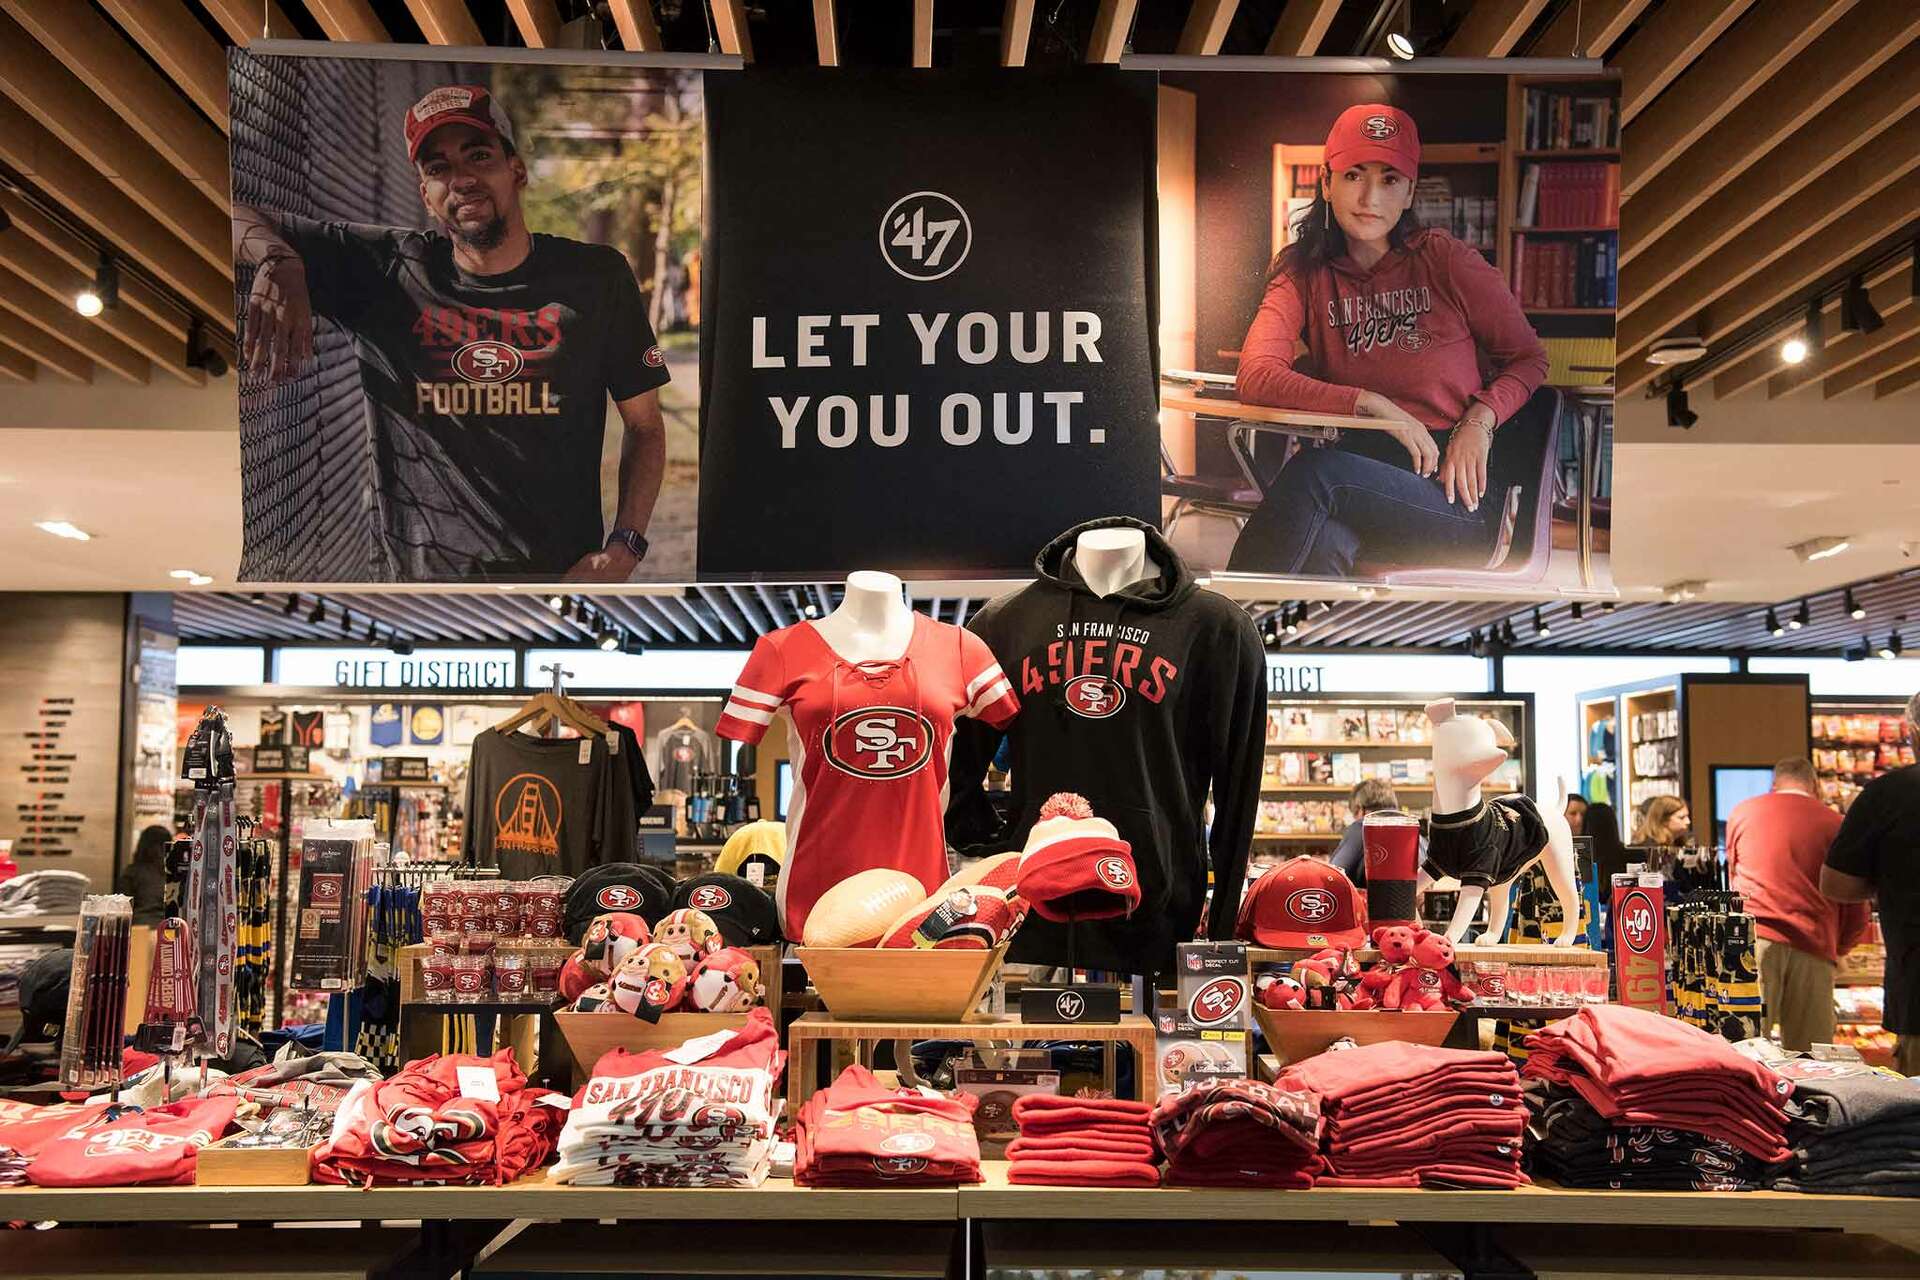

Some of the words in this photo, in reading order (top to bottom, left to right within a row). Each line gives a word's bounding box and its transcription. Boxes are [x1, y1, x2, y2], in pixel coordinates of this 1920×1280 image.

[1328, 298, 1352, 328] SN
[1357, 286, 1432, 322] FRANCISCO
[412, 303, 563, 348] 49ERS
[752, 314, 880, 368] LET
[907, 311, 1104, 366] YOUR
[472, 347, 510, 378] SF
[415, 381, 561, 416] FOOTBALL
[768, 394, 909, 449] YOU
[940, 391, 1106, 447] OUT.
[335, 660, 389, 687] GIFT
[401, 660, 511, 687] DISTRICT
[1021, 639, 1178, 705] 49ERS
[1079, 680, 1114, 713] SF
[855, 717, 917, 769] SF
[1105, 860, 1129, 882] SF
[608, 888, 635, 907] SF
[697, 888, 723, 907] SF
[1300, 893, 1330, 918] SF
[1201, 985, 1235, 1015] SF
[587, 1080, 634, 1104] SAN
[636, 1068, 754, 1104] FRANCISCO
